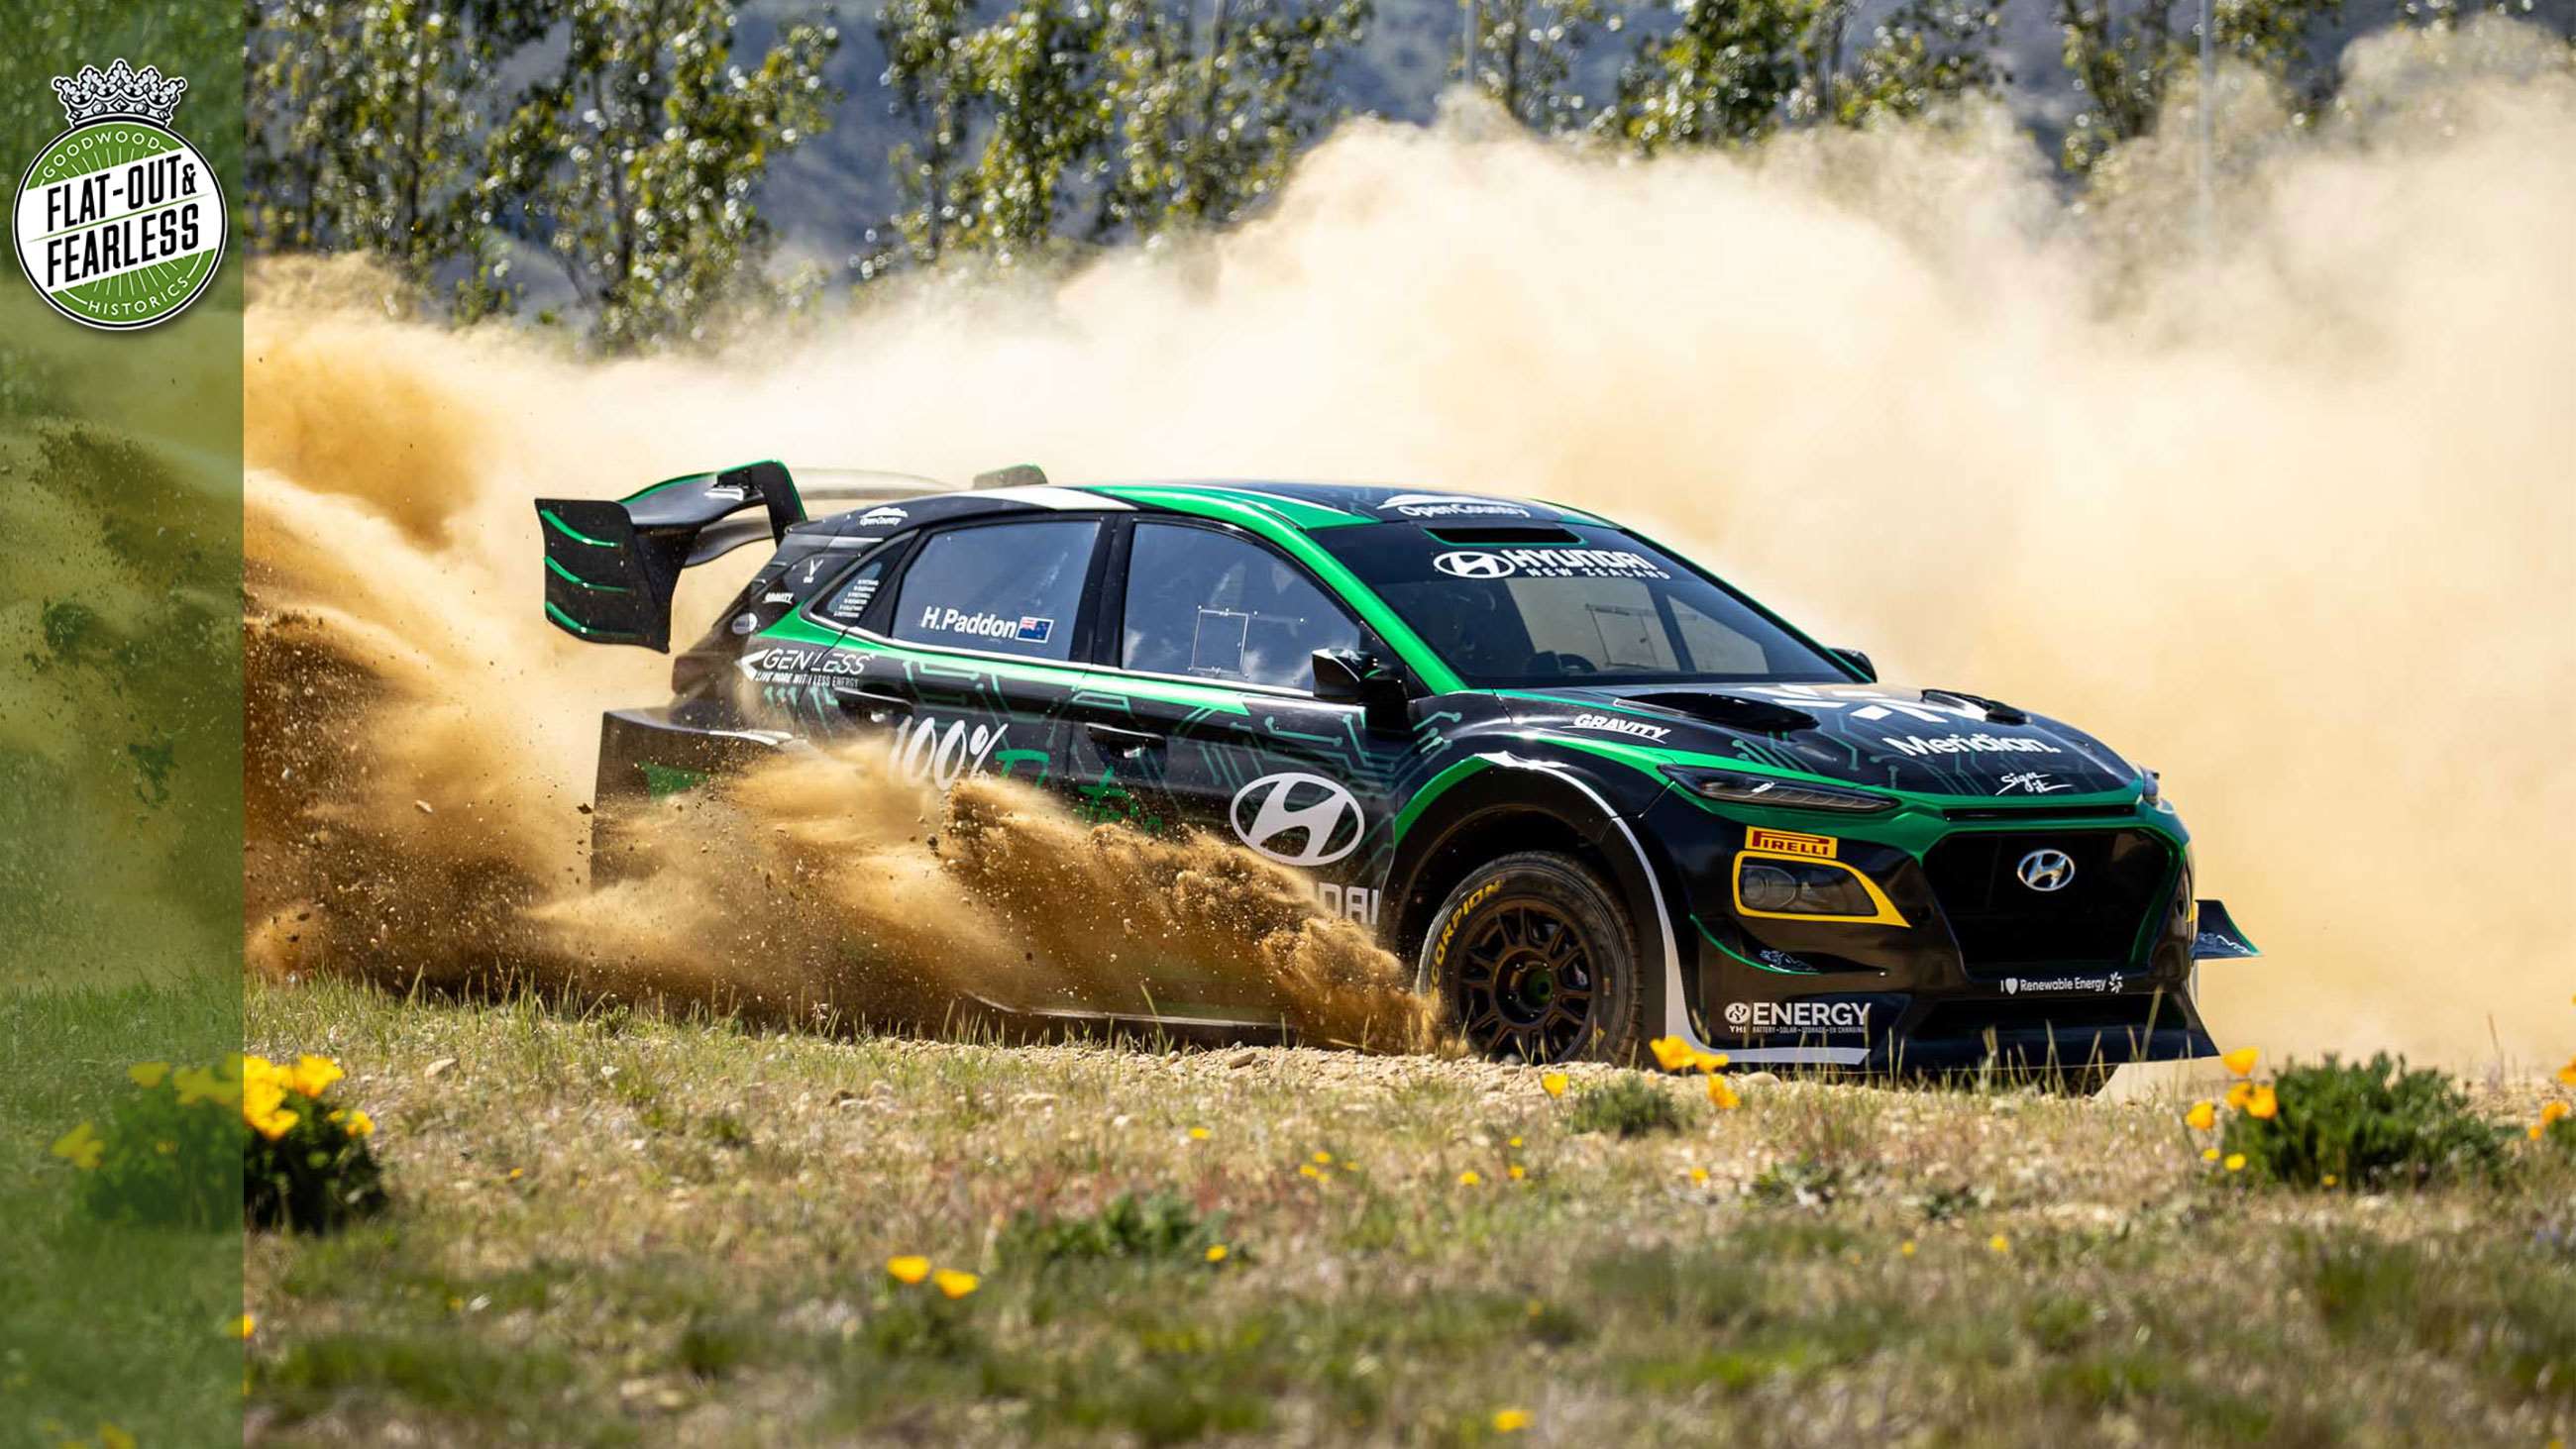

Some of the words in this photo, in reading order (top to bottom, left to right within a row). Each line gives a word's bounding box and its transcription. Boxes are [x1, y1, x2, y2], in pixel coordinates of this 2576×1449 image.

[1500, 550, 1659, 570] HYUNDAI
[1526, 568, 1573, 577] NEW
[1581, 568, 1672, 580] ZEALAND
[1573, 713, 1672, 739] GRAVITY
[1751, 829, 1830, 856] PIRELLI
[2019, 978, 2074, 991] Renewable
[2075, 977, 2107, 992] Energy
[1753, 1001, 1872, 1026] ENERGY
